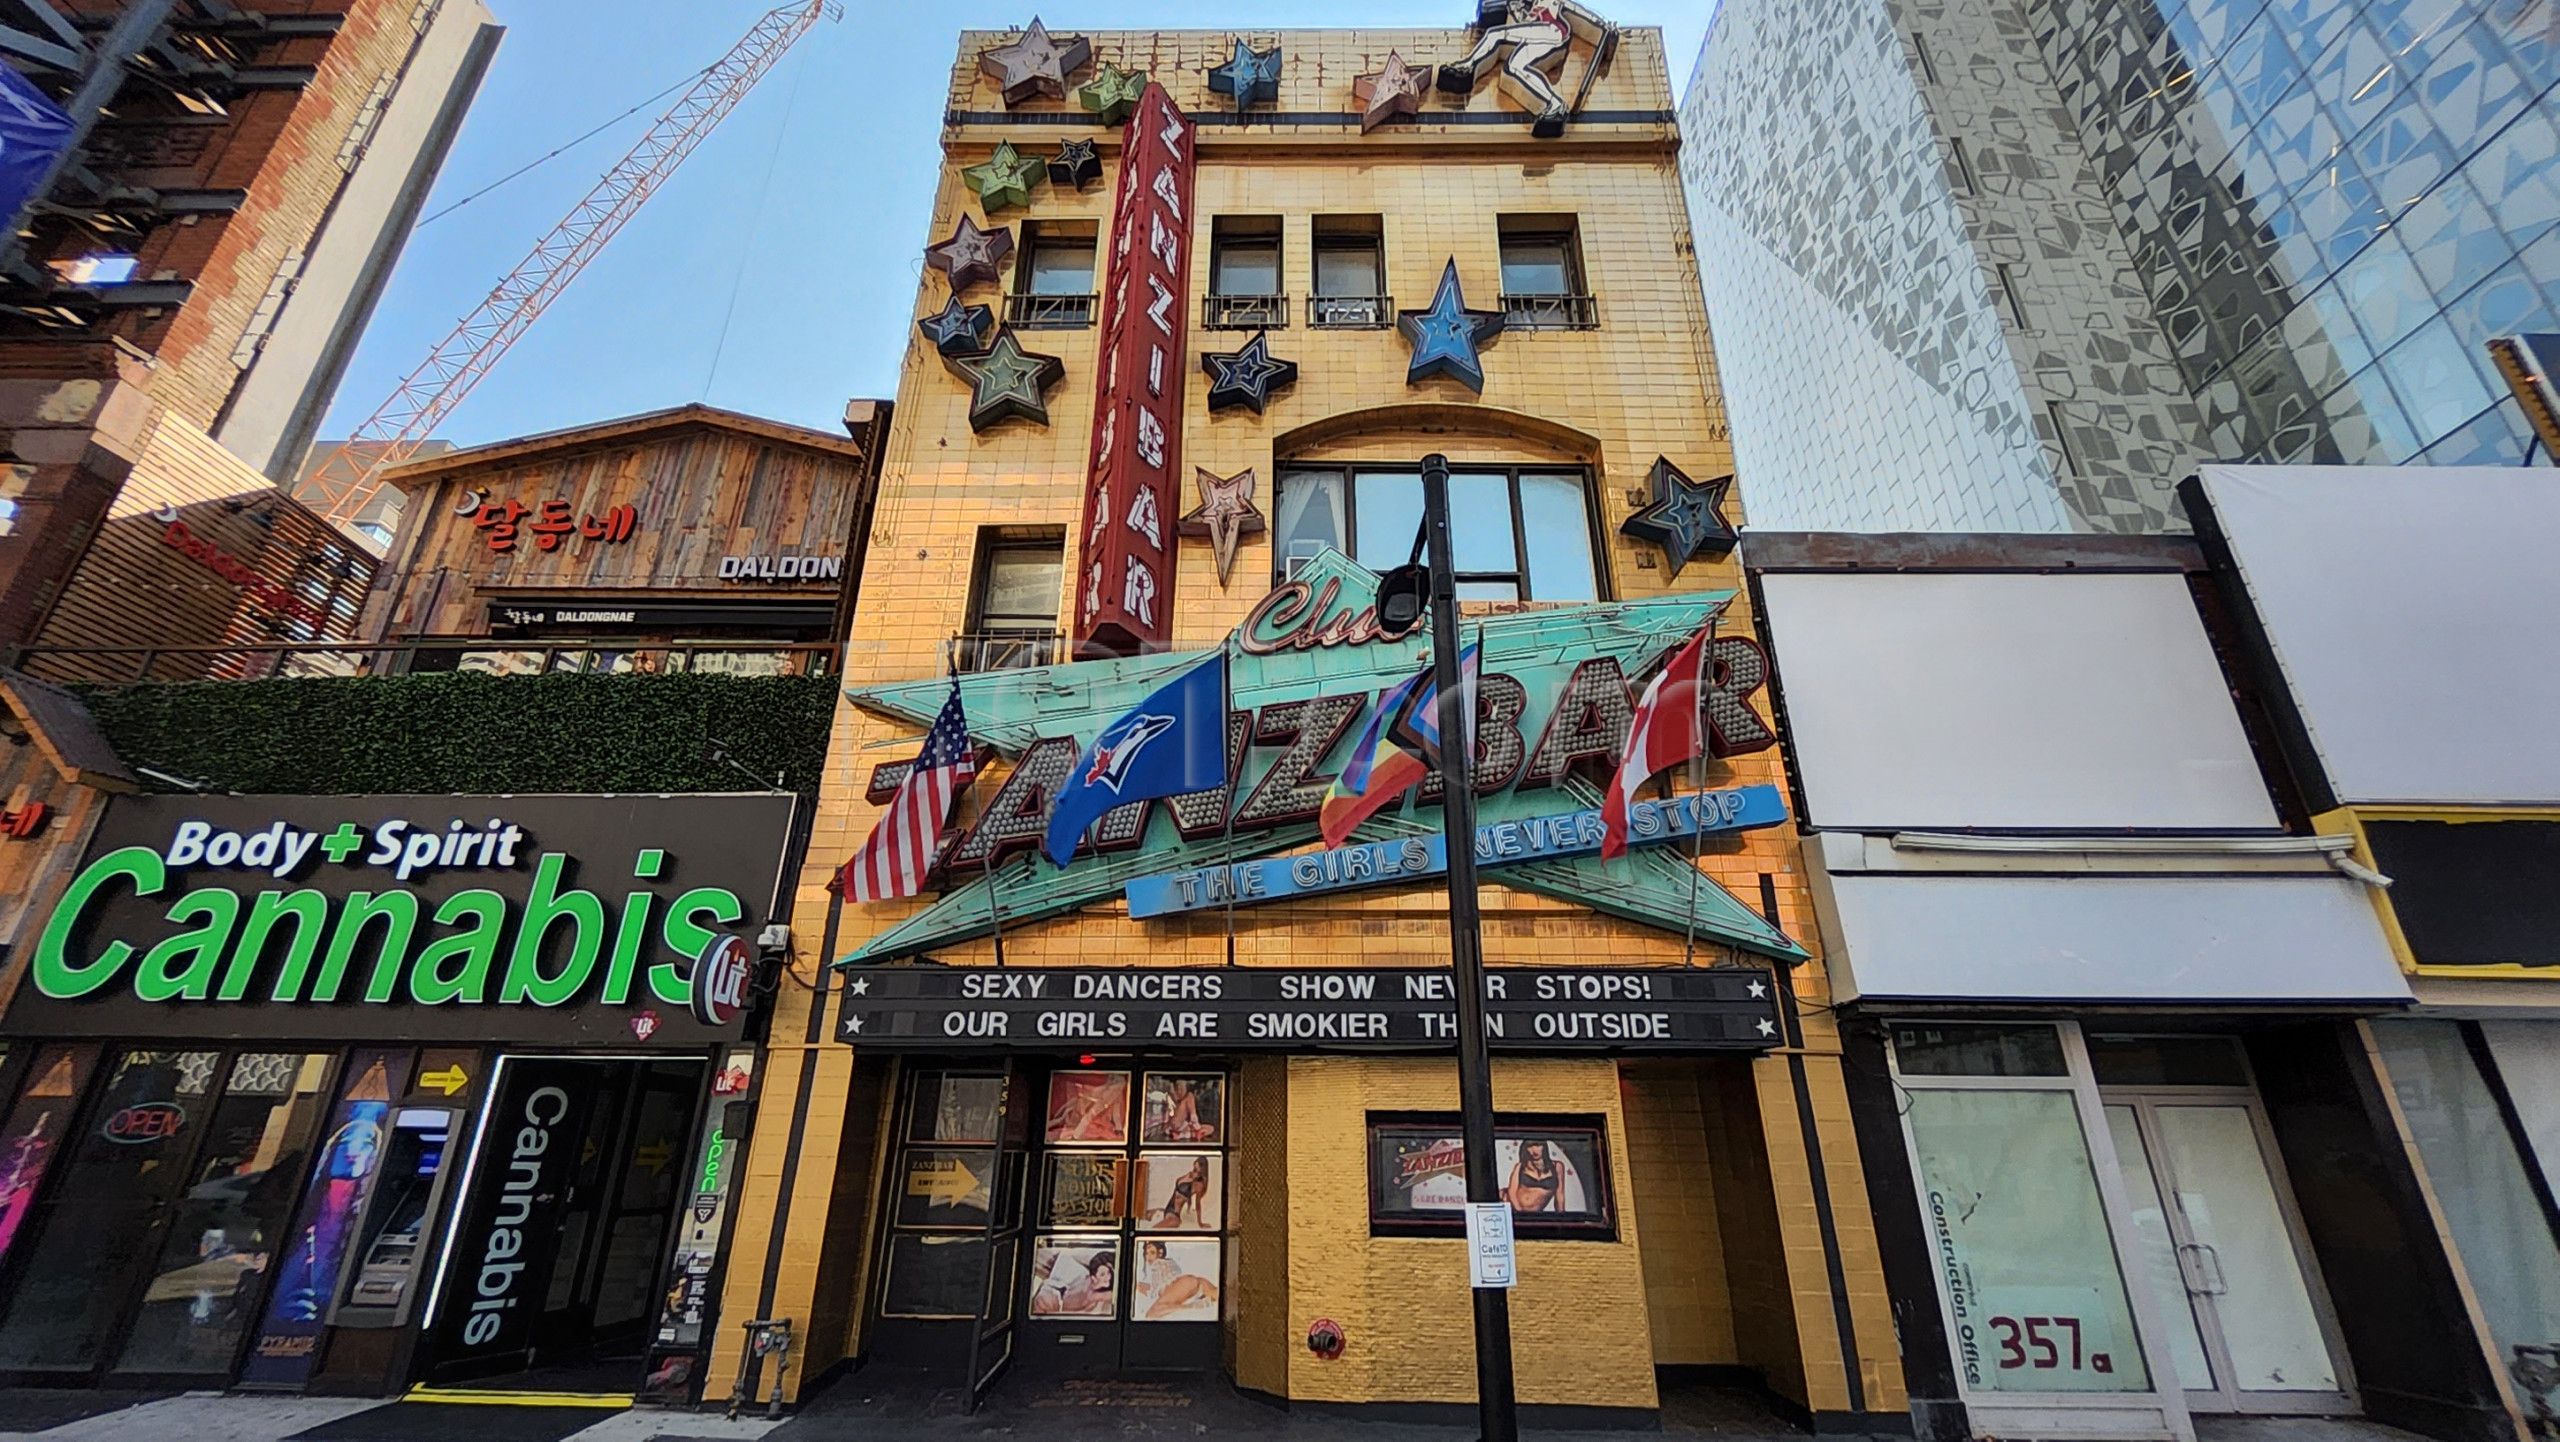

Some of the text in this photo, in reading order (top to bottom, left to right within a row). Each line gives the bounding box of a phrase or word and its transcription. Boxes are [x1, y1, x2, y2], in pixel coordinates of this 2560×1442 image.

[1122, 101, 1185, 630] ZANZIBAR
[473, 500, 638, 551] 달동네
[555, 611, 636, 623] DALDONGNAE
[1240, 576, 1424, 655] Clu
[166, 820, 320, 877] Body
[367, 818, 525, 880] Spirit
[1174, 791, 1747, 906] THE GIRLS NEVER STOP
[32, 846, 742, 1006] Cannabis
[714, 948, 748, 1008] Lit
[962, 973, 1652, 1000] SEXY DANCERS SHOW NER STOPS!
[943, 1010, 1672, 1039] OUR GIRLS ARE SMOKIER THN OUTSIDE
[110, 1107, 180, 1138] OPEN
[463, 1085, 569, 1347] Cannabis
[1929, 1190, 1968, 1319] Construction
[1960, 1324, 1982, 1385] Office
